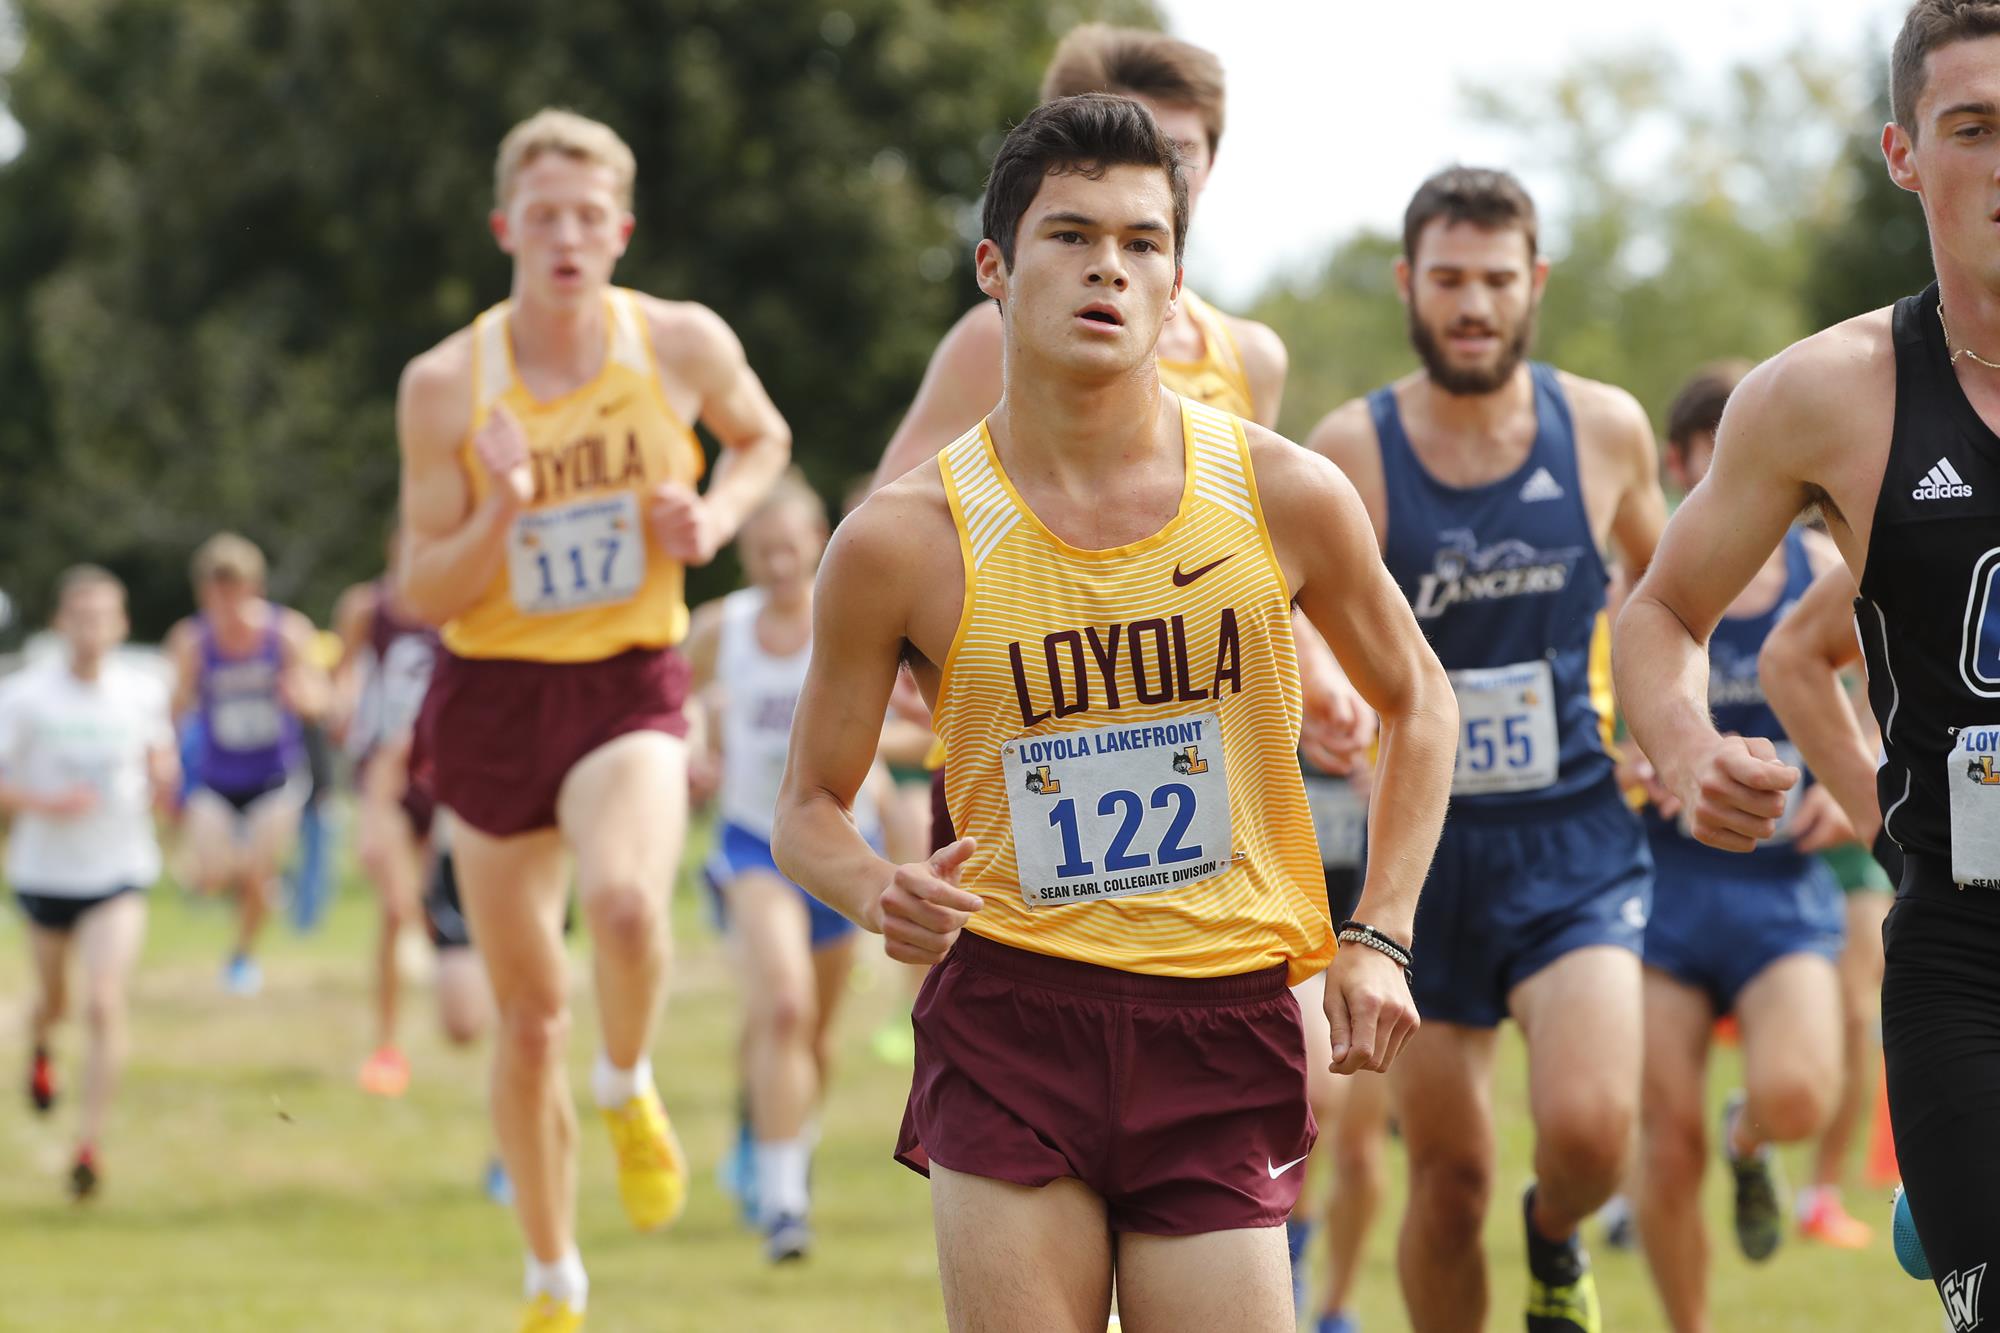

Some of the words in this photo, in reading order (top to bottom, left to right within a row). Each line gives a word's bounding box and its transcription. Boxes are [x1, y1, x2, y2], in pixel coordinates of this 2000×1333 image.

[1912, 483, 1973, 500] adidas
[536, 538, 620, 596] 117
[1008, 608, 1241, 727] LOYOLA
[1019, 736, 1091, 764] LOYOLA
[1095, 720, 1202, 754] LAKEFRONT
[1456, 714, 1533, 772] 55
[1048, 783, 1203, 879] 122
[1040, 885, 1070, 899] SEAN
[1073, 882, 1101, 896] EARL
[1104, 872, 1169, 892] COLLEGIATE
[1173, 860, 1216, 882] DIVISION
